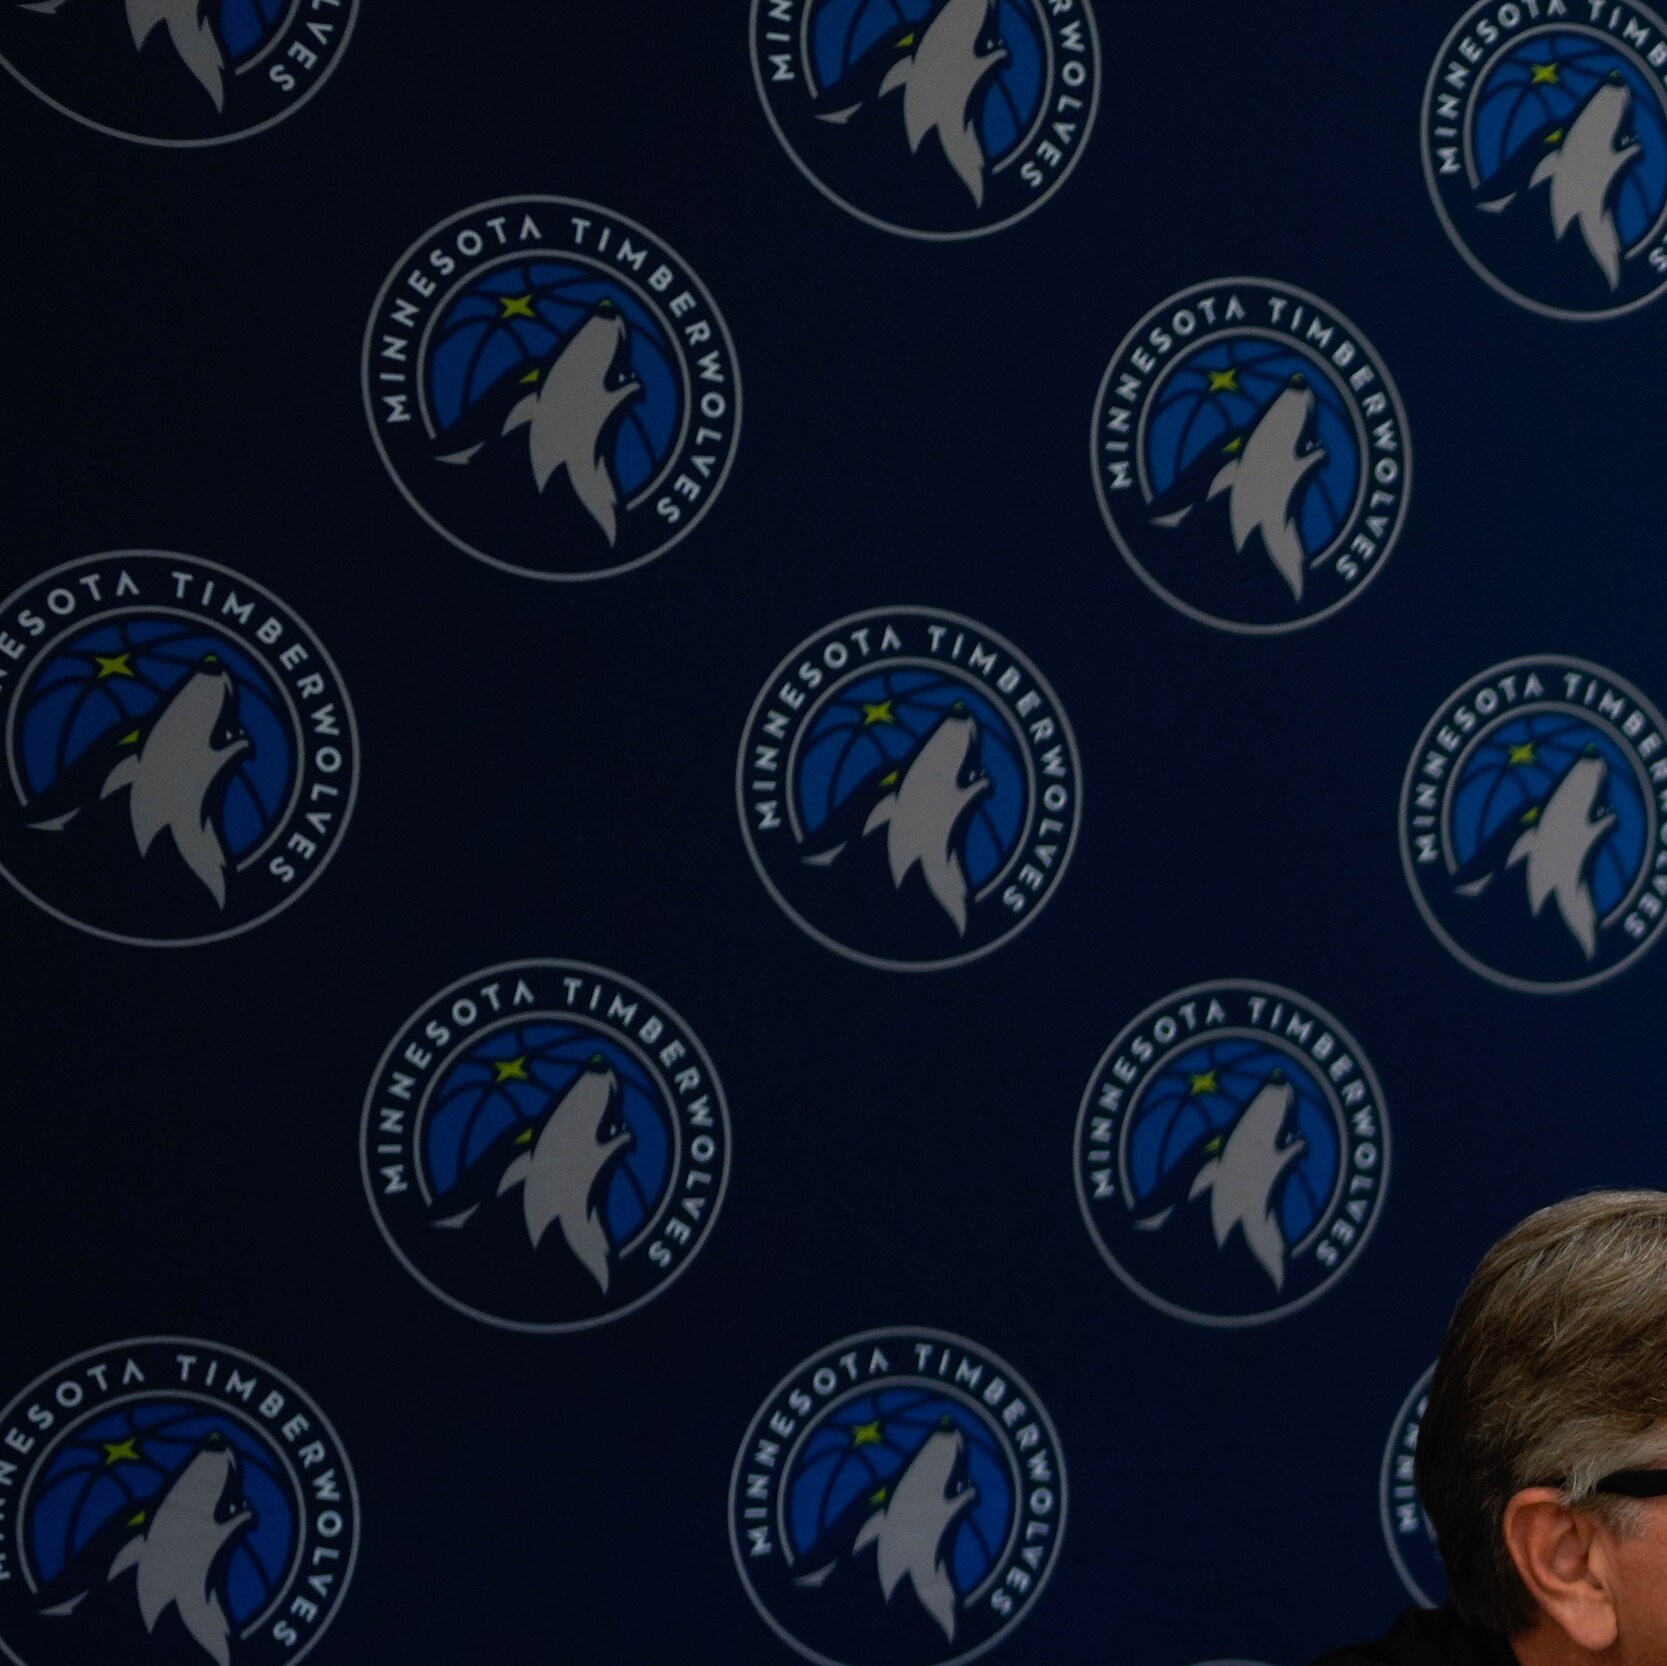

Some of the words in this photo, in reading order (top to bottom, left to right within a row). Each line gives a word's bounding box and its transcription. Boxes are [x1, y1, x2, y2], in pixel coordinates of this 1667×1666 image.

[1020, 0, 1085, 187] RWOLVES
[378, 213, 541, 423] MINNESOTA
[570, 215, 725, 523] TIMBERWOLVES
[1105, 295, 1244, 489] MINNESOTA
[1268, 296, 1397, 580] TIMBERWOLVES
[0, 569, 139, 660] ESOTA
[170, 569, 342, 883] TIMBERWOLVES
[752, 625, 901, 829] MINNESOTA
[927, 624, 1067, 911] TIMBERWOLVES
[1413, 673, 1542, 861] MINNESOTA
[376, 978, 534, 1194] MINNESOTA
[562, 976, 715, 1267] TIMBERWOLVES
[1088, 999, 1225, 1197] MINNESOTA
[1248, 996, 1376, 1265] TIMBERWOLVES
[0, 1357, 145, 1583] NESOTA
[175, 1353, 343, 1646] TIMBERWOLVES
[744, 1347, 888, 1555] MINNESOTA
[914, 1343, 1053, 1614] TIMBERWOLVES
